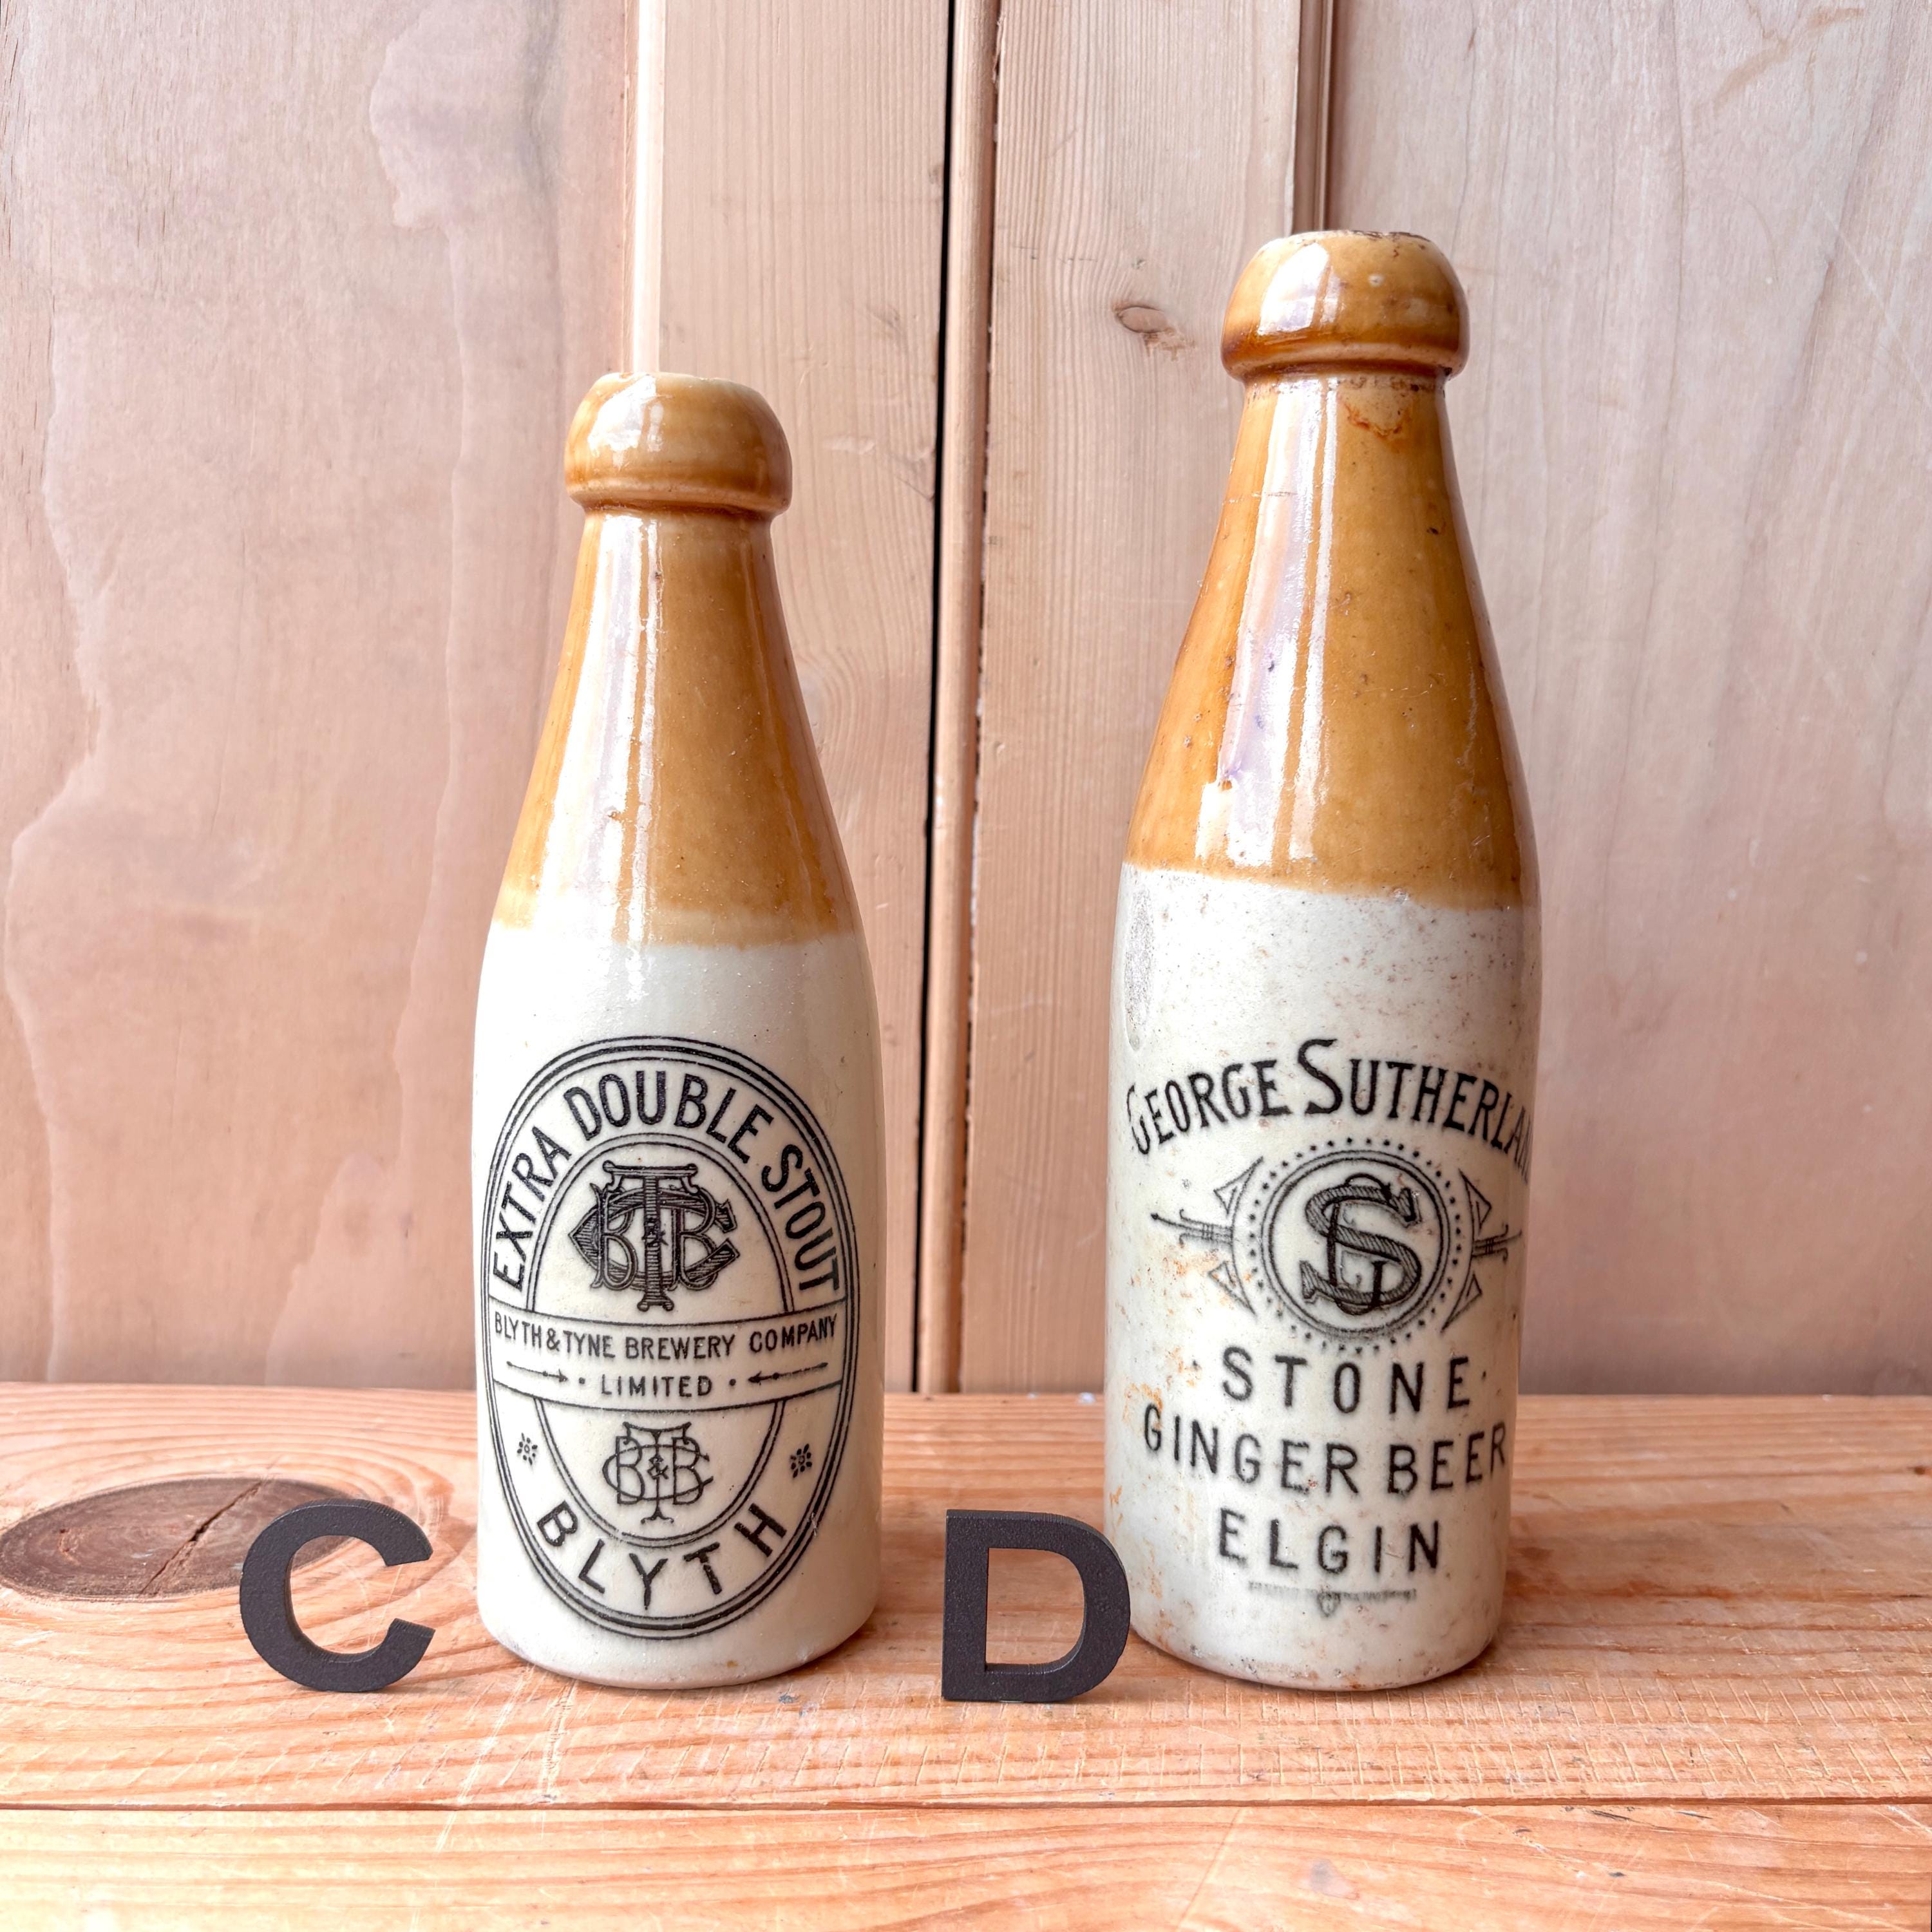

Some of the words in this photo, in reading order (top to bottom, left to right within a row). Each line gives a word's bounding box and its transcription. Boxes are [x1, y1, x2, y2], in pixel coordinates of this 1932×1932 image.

[1126, 1059, 1291, 1155] GEORGE
[491, 1126, 571, 1293] EXTRA
[563, 1069, 773, 1165] DOUBLE
[761, 1145, 842, 1293] STOUT
[625, 1333, 735, 1359] BREWERY
[750, 1314, 838, 1352] COMPANY
[1223, 1346, 1470, 1414] STONE
[601, 1374, 713, 1397] LIMITED
[1144, 1403, 1359, 1494] GINGER
[1387, 1421, 1506, 1494] BEER
[536, 1502, 788, 1611] BLYTH
[1219, 1507, 1440, 1575] ELGIN
[240, 1499, 435, 1693] C
[941, 1509, 1131, 1703] D
